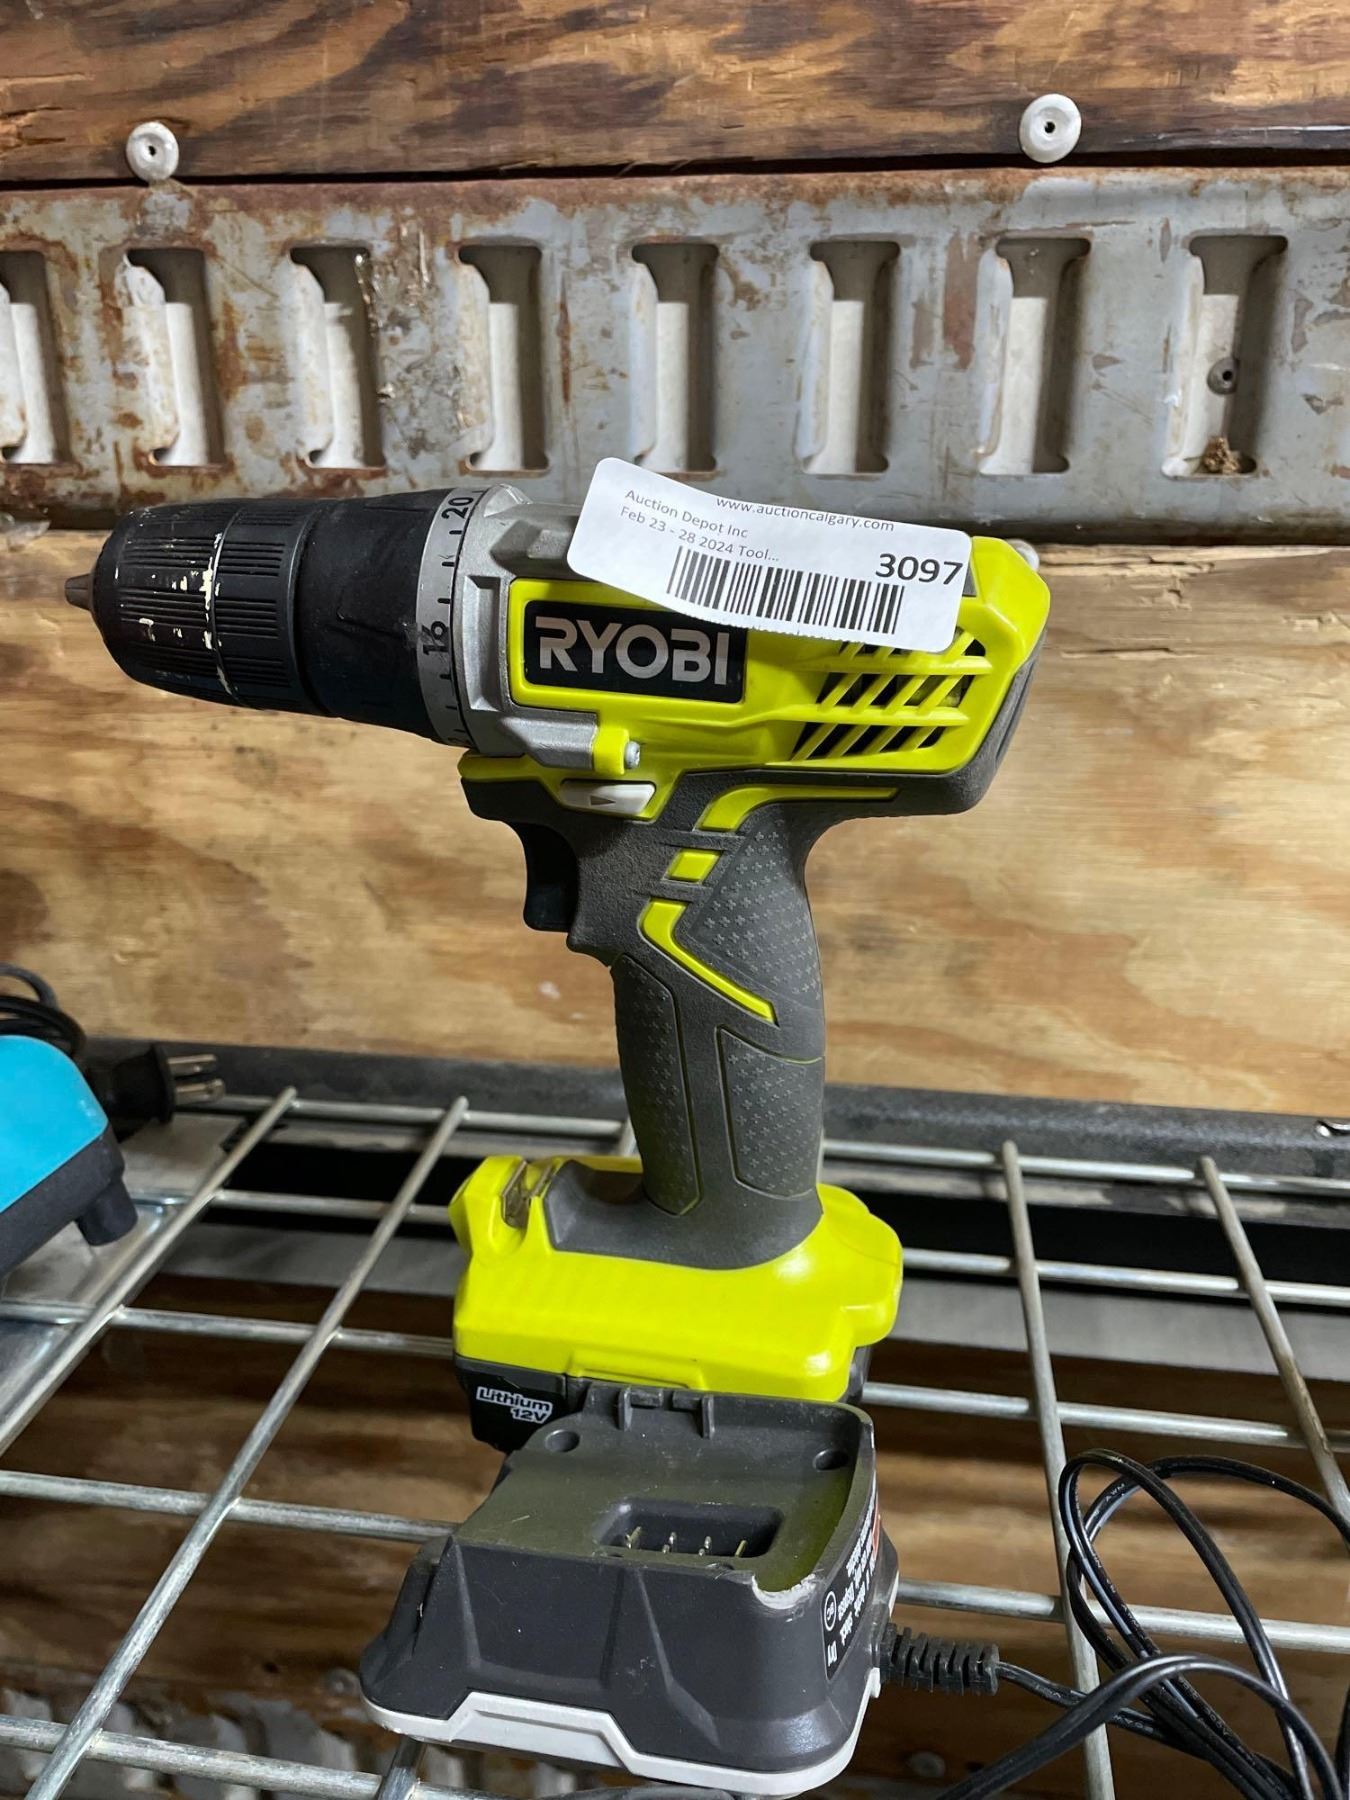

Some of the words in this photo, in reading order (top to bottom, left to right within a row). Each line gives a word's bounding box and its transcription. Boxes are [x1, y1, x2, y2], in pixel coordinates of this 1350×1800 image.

[441, 496, 474, 519] 20
[624, 489, 679, 518] Auction
[682, 510, 724, 534] Depot
[727, 524, 749, 539] Inc
[716, 497, 895, 532] www.auctioncalgary.com
[620, 506, 646, 524] Feb
[649, 517, 667, 532] 23
[678, 528, 697, 544] 28
[699, 537, 734, 554] 2024
[738, 545, 780, 562] Tool...
[875, 552, 964, 586] 3097
[534, 615, 731, 687] RYOBI
[475, 1386, 553, 1413] Lithium
[510, 1407, 550, 1424] 12V
